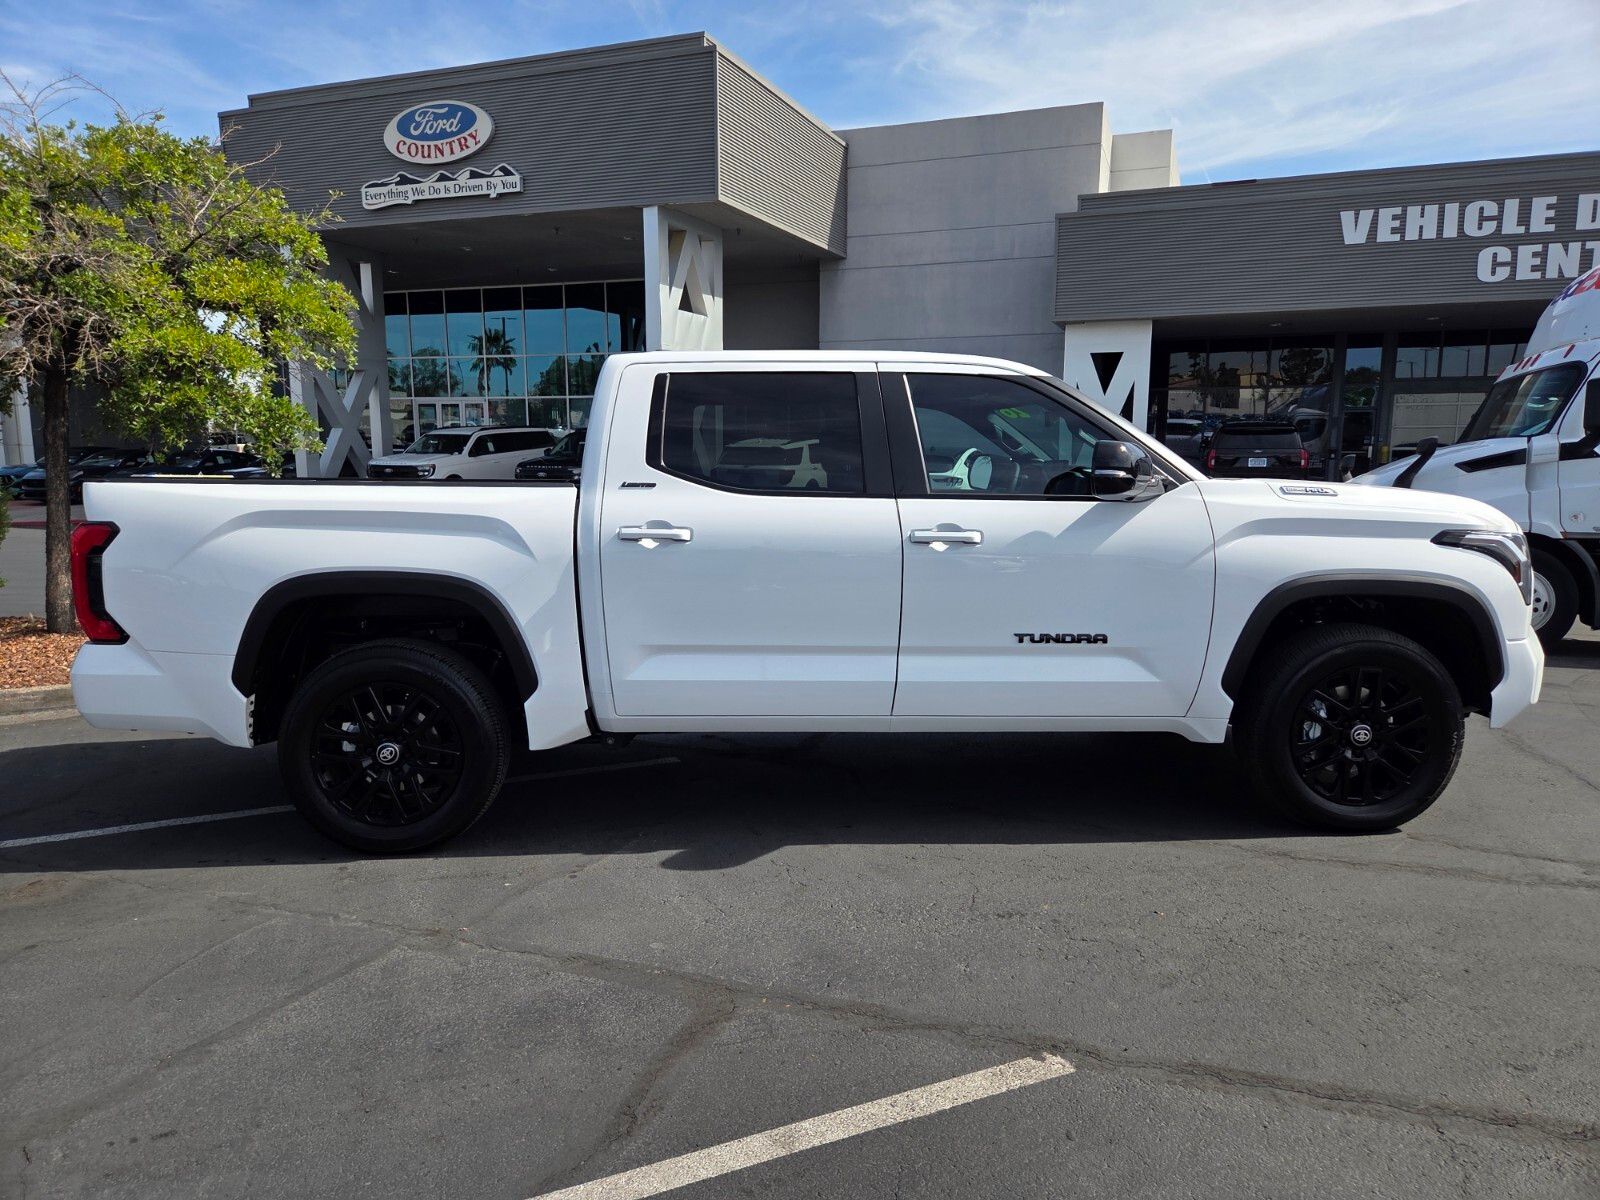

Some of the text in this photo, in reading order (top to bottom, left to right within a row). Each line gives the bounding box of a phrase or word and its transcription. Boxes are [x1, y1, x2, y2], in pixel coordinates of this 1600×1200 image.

[410, 106, 461, 136] Ford
[396, 129, 481, 159] COUNTRY
[365, 180, 517, 202] Everything We Do Is Driven By You
[1340, 196, 1557, 244] VEHICLE
[1013, 633, 1108, 644] TUNDRA
